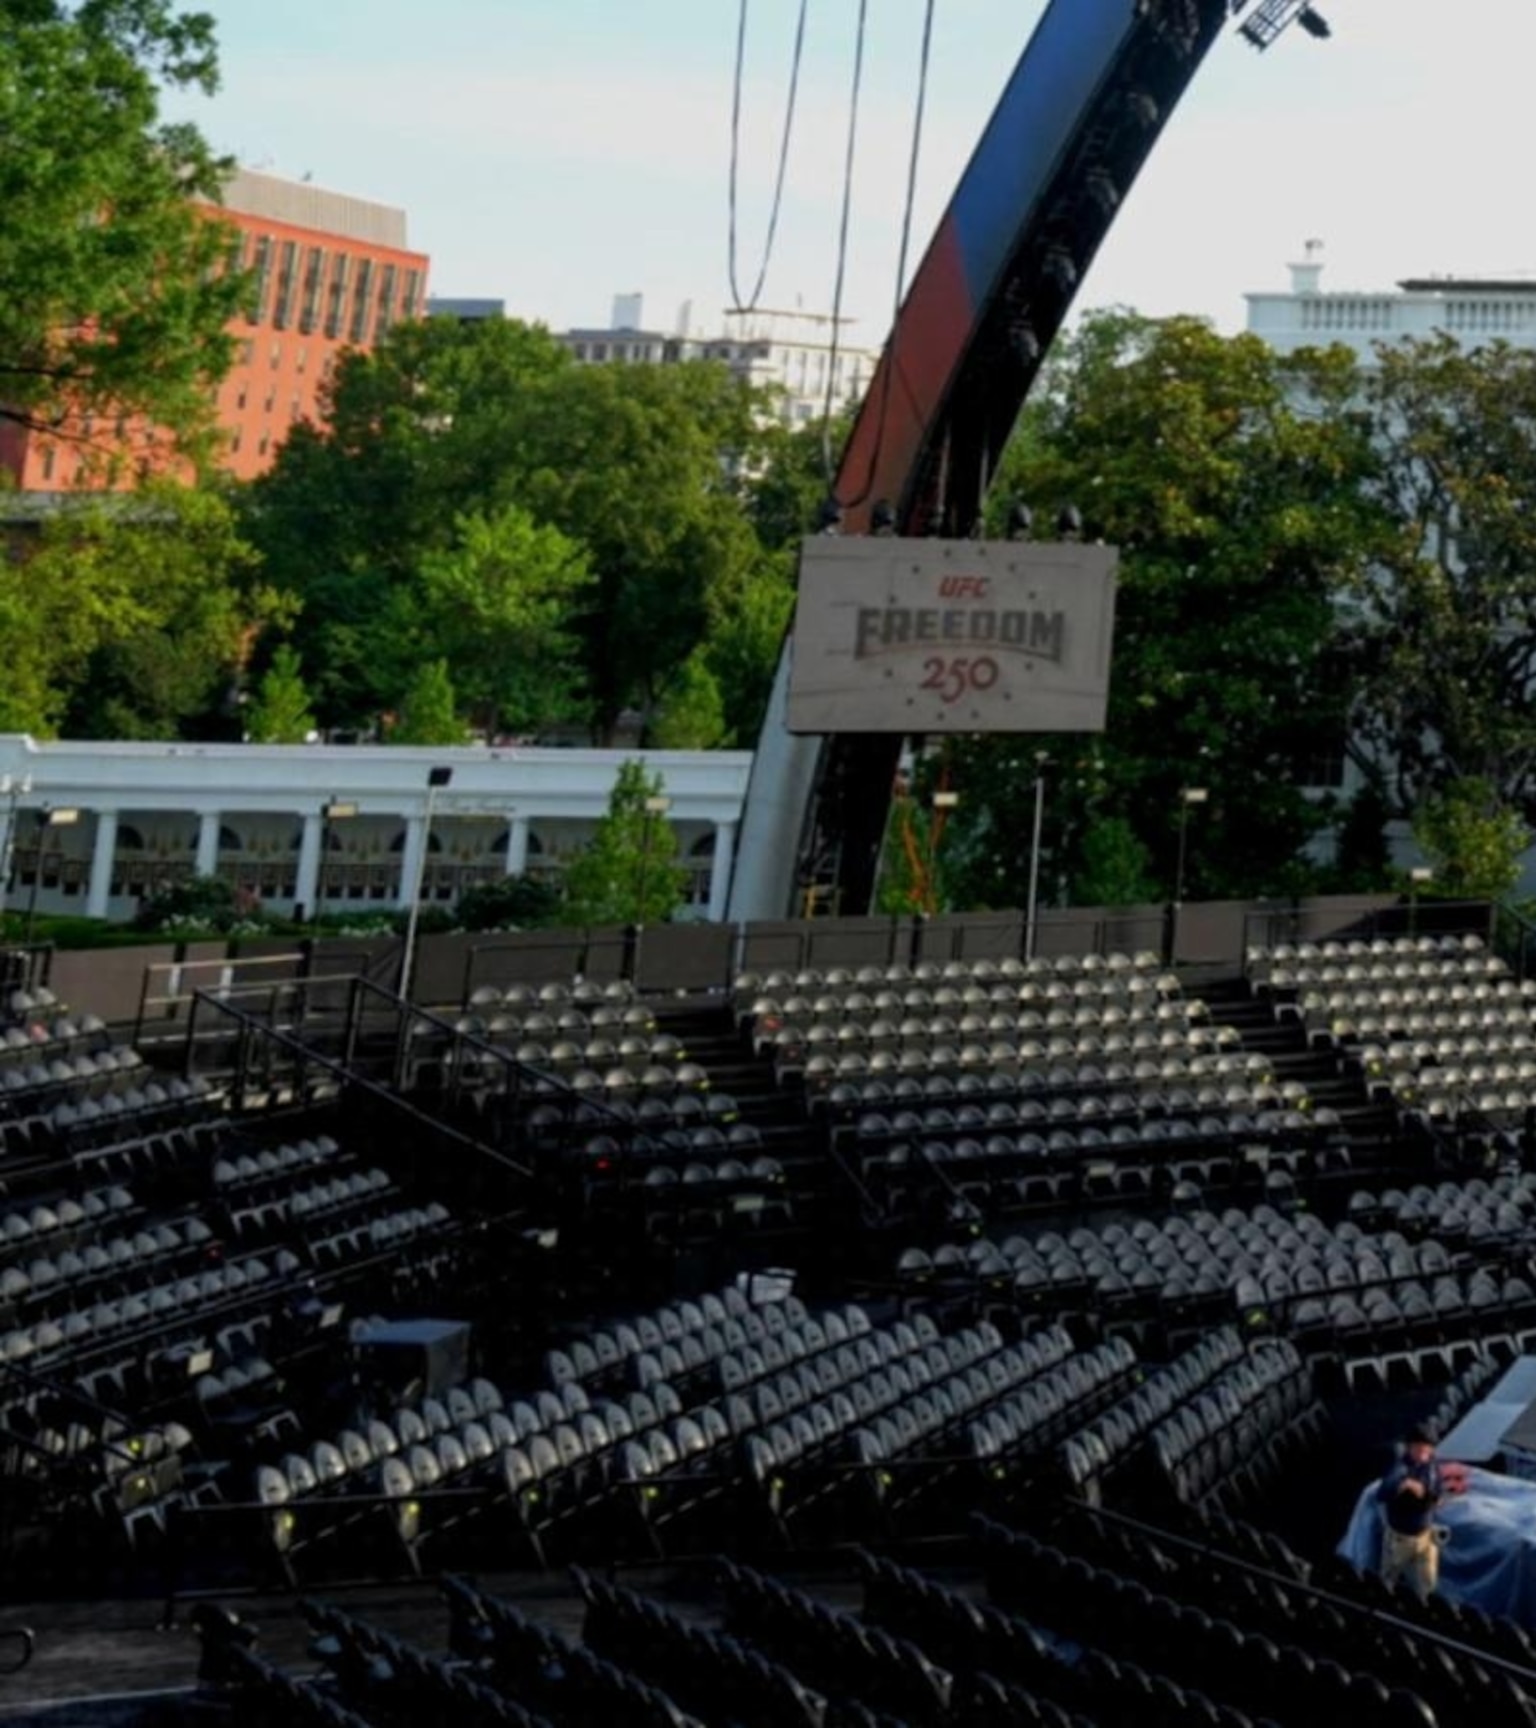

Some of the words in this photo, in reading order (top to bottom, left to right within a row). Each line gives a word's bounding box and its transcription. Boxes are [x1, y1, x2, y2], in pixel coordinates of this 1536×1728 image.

[939, 577, 991, 597] UFC
[856, 608, 1064, 662] FREEDOM
[920, 657, 1000, 702] 250
